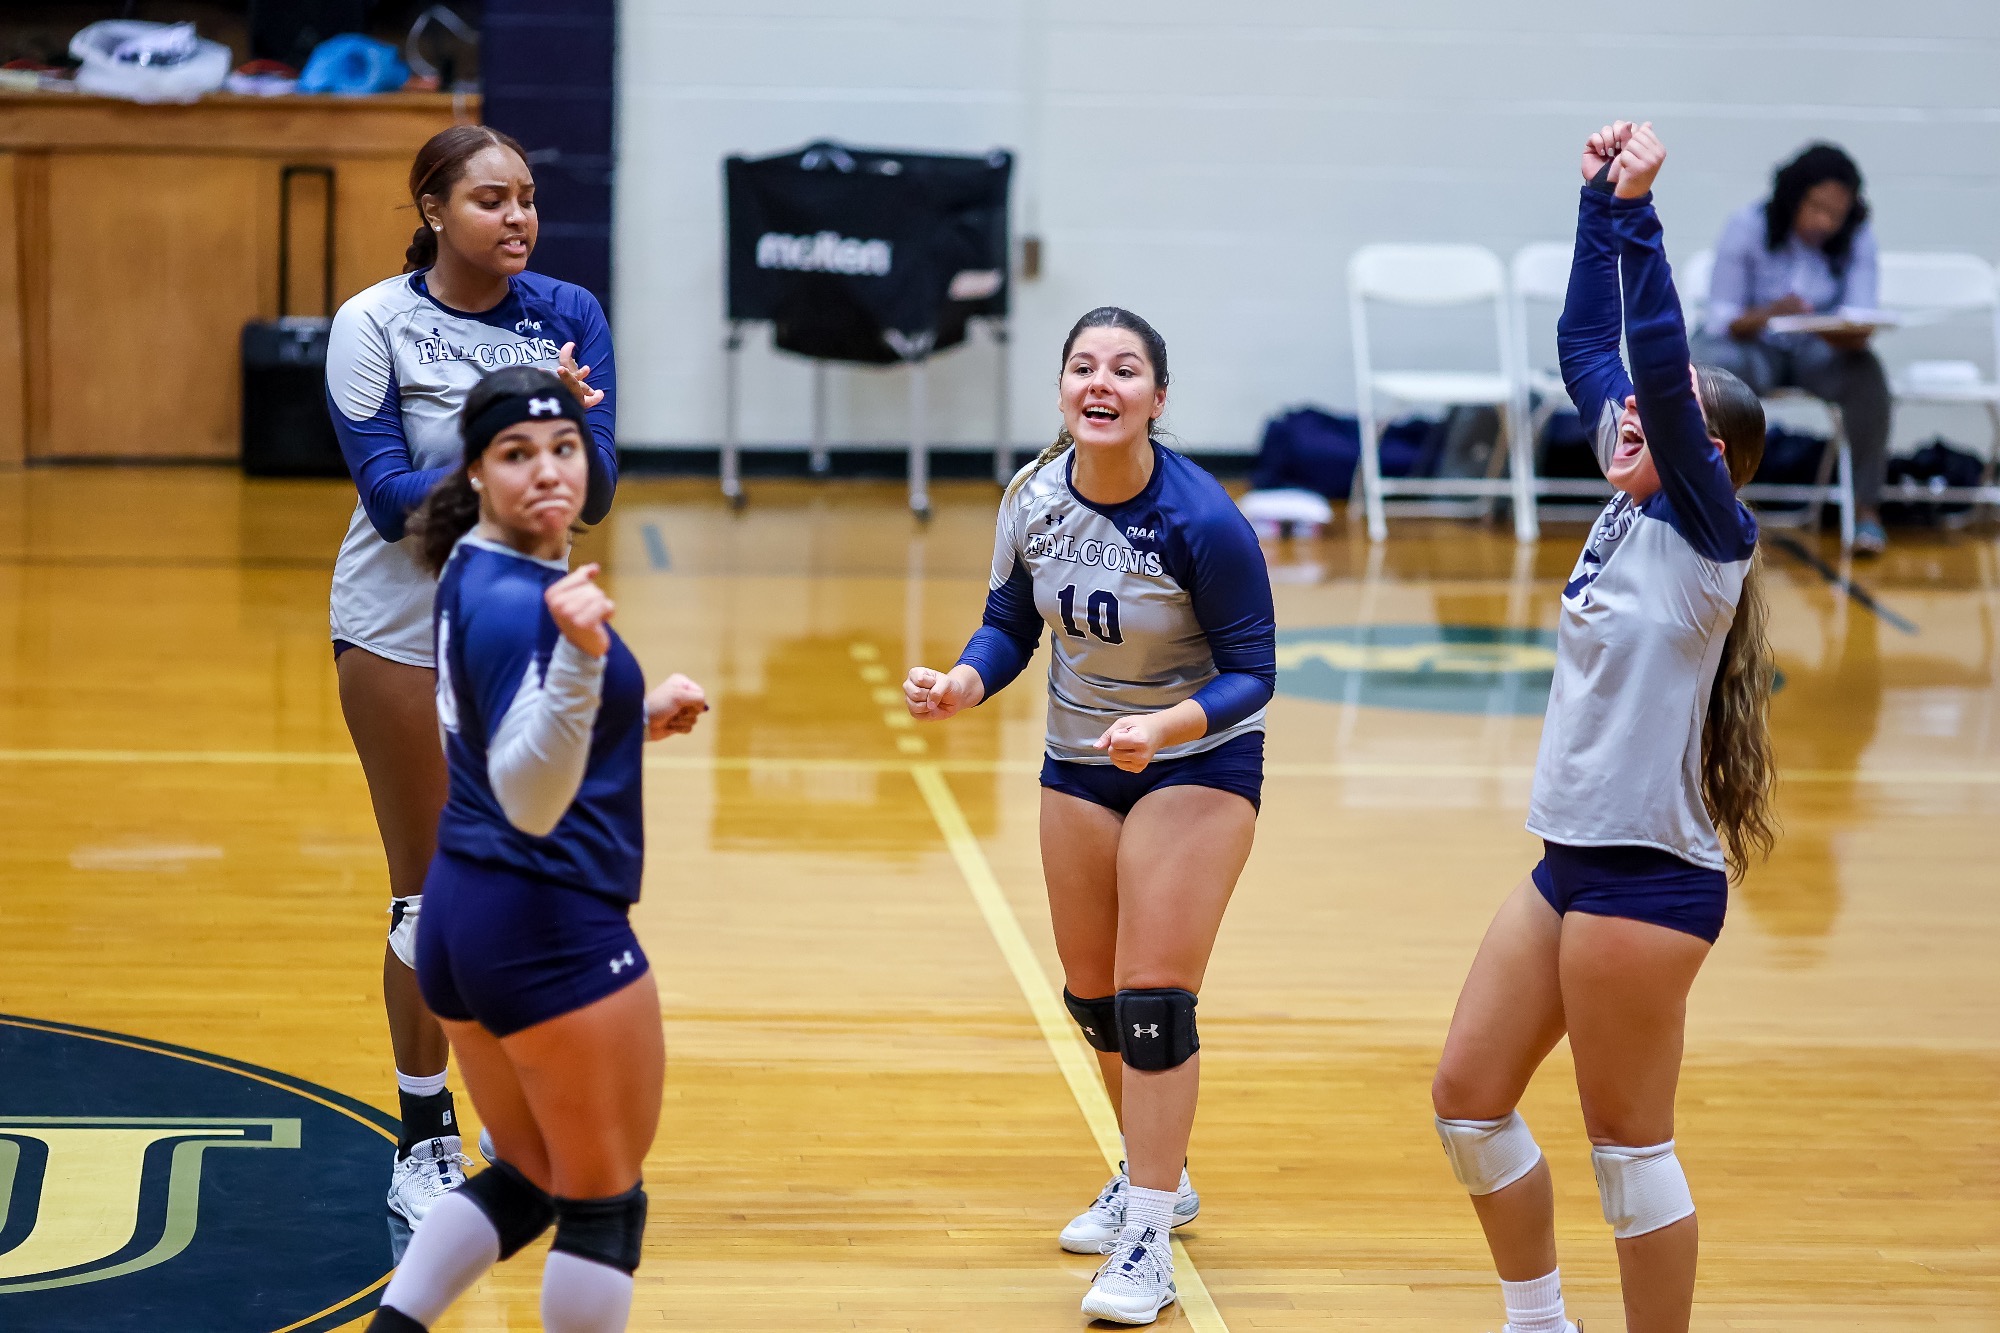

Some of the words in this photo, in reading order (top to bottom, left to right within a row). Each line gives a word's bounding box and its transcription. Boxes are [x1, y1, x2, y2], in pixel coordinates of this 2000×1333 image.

[1025, 533, 1164, 577] FALCONS
[1126, 526, 1157, 542] CIAA
[1056, 583, 1124, 646] 10
